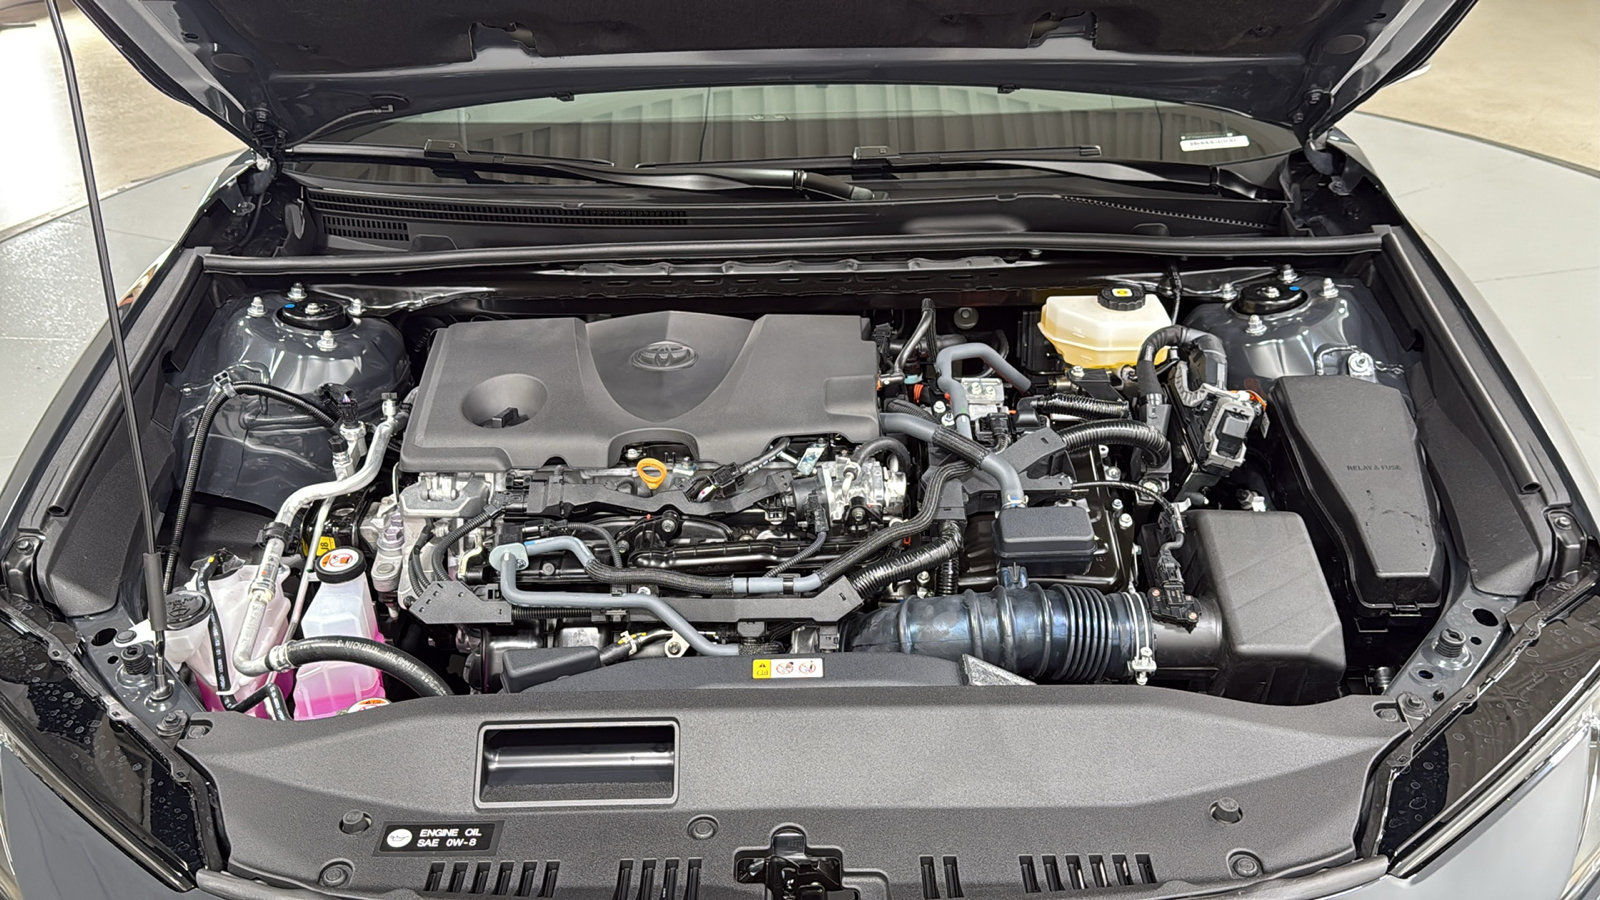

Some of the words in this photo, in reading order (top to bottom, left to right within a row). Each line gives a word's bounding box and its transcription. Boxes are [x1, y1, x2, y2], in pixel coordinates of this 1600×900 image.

[420, 828, 459, 837] ENGINE
[464, 828, 482, 837] OIL
[416, 838, 440, 847] SAE
[445, 838, 477, 847] 0W-8
